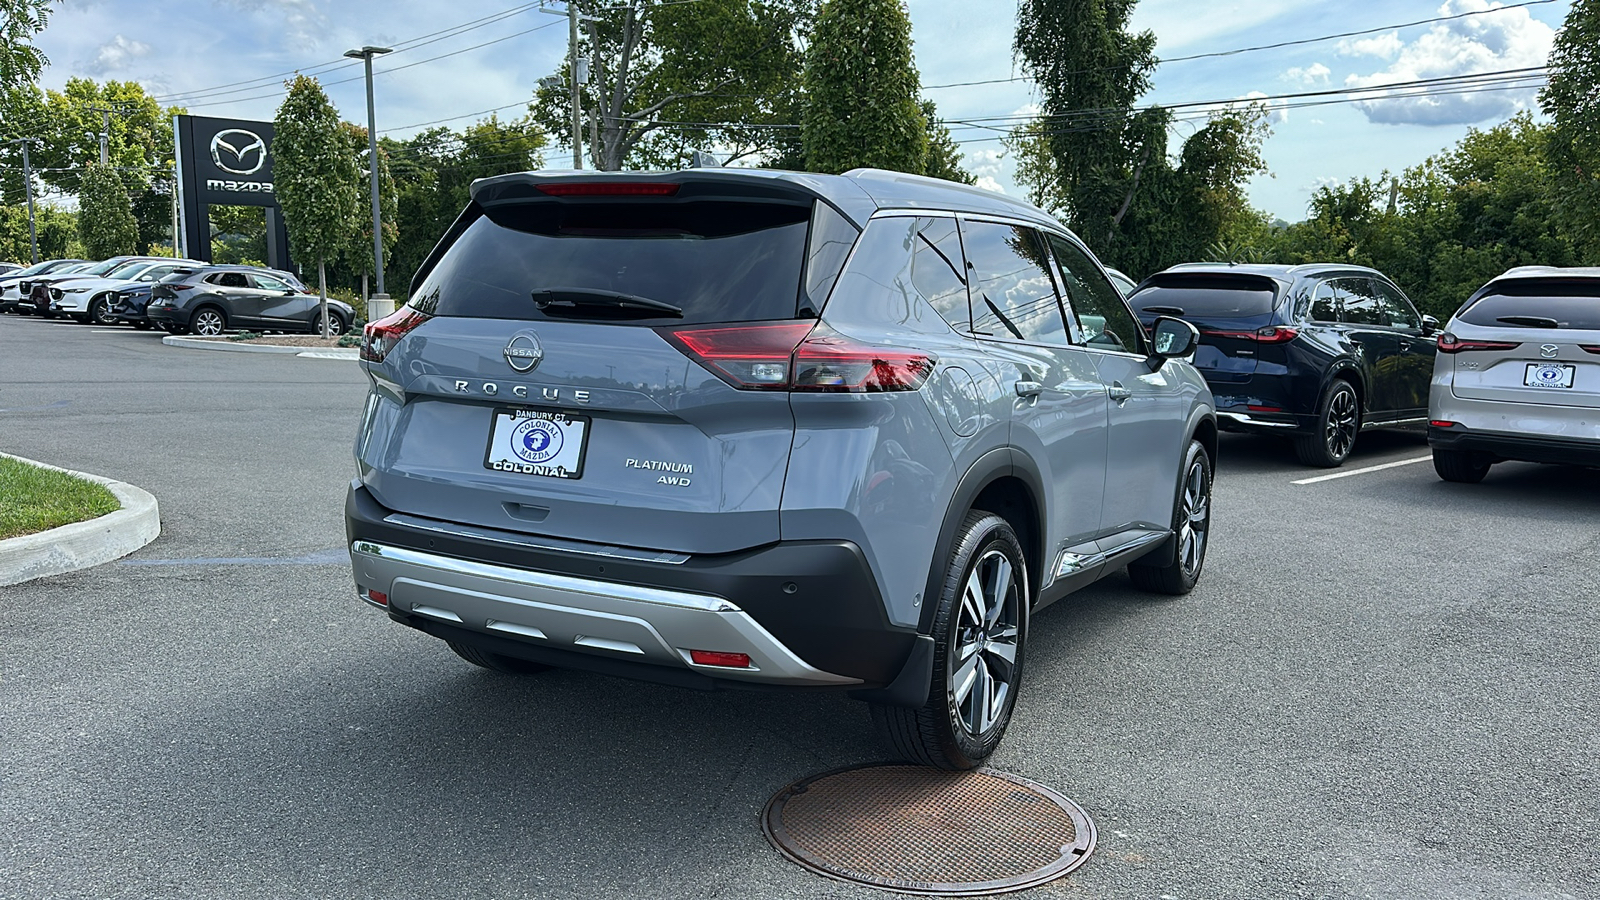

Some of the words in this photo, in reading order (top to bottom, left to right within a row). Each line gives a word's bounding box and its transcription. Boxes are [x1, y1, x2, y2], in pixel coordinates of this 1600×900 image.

[503, 348, 542, 358] NISSAN
[455, 380, 590, 403] ROGUE
[554, 413, 566, 422] CT
[519, 420, 559, 438] COLONIAL
[519, 447, 550, 461] MAZDA
[493, 461, 569, 478] COLONIAL
[625, 458, 694, 474] PLATINUM
[656, 475, 692, 487] AWD
